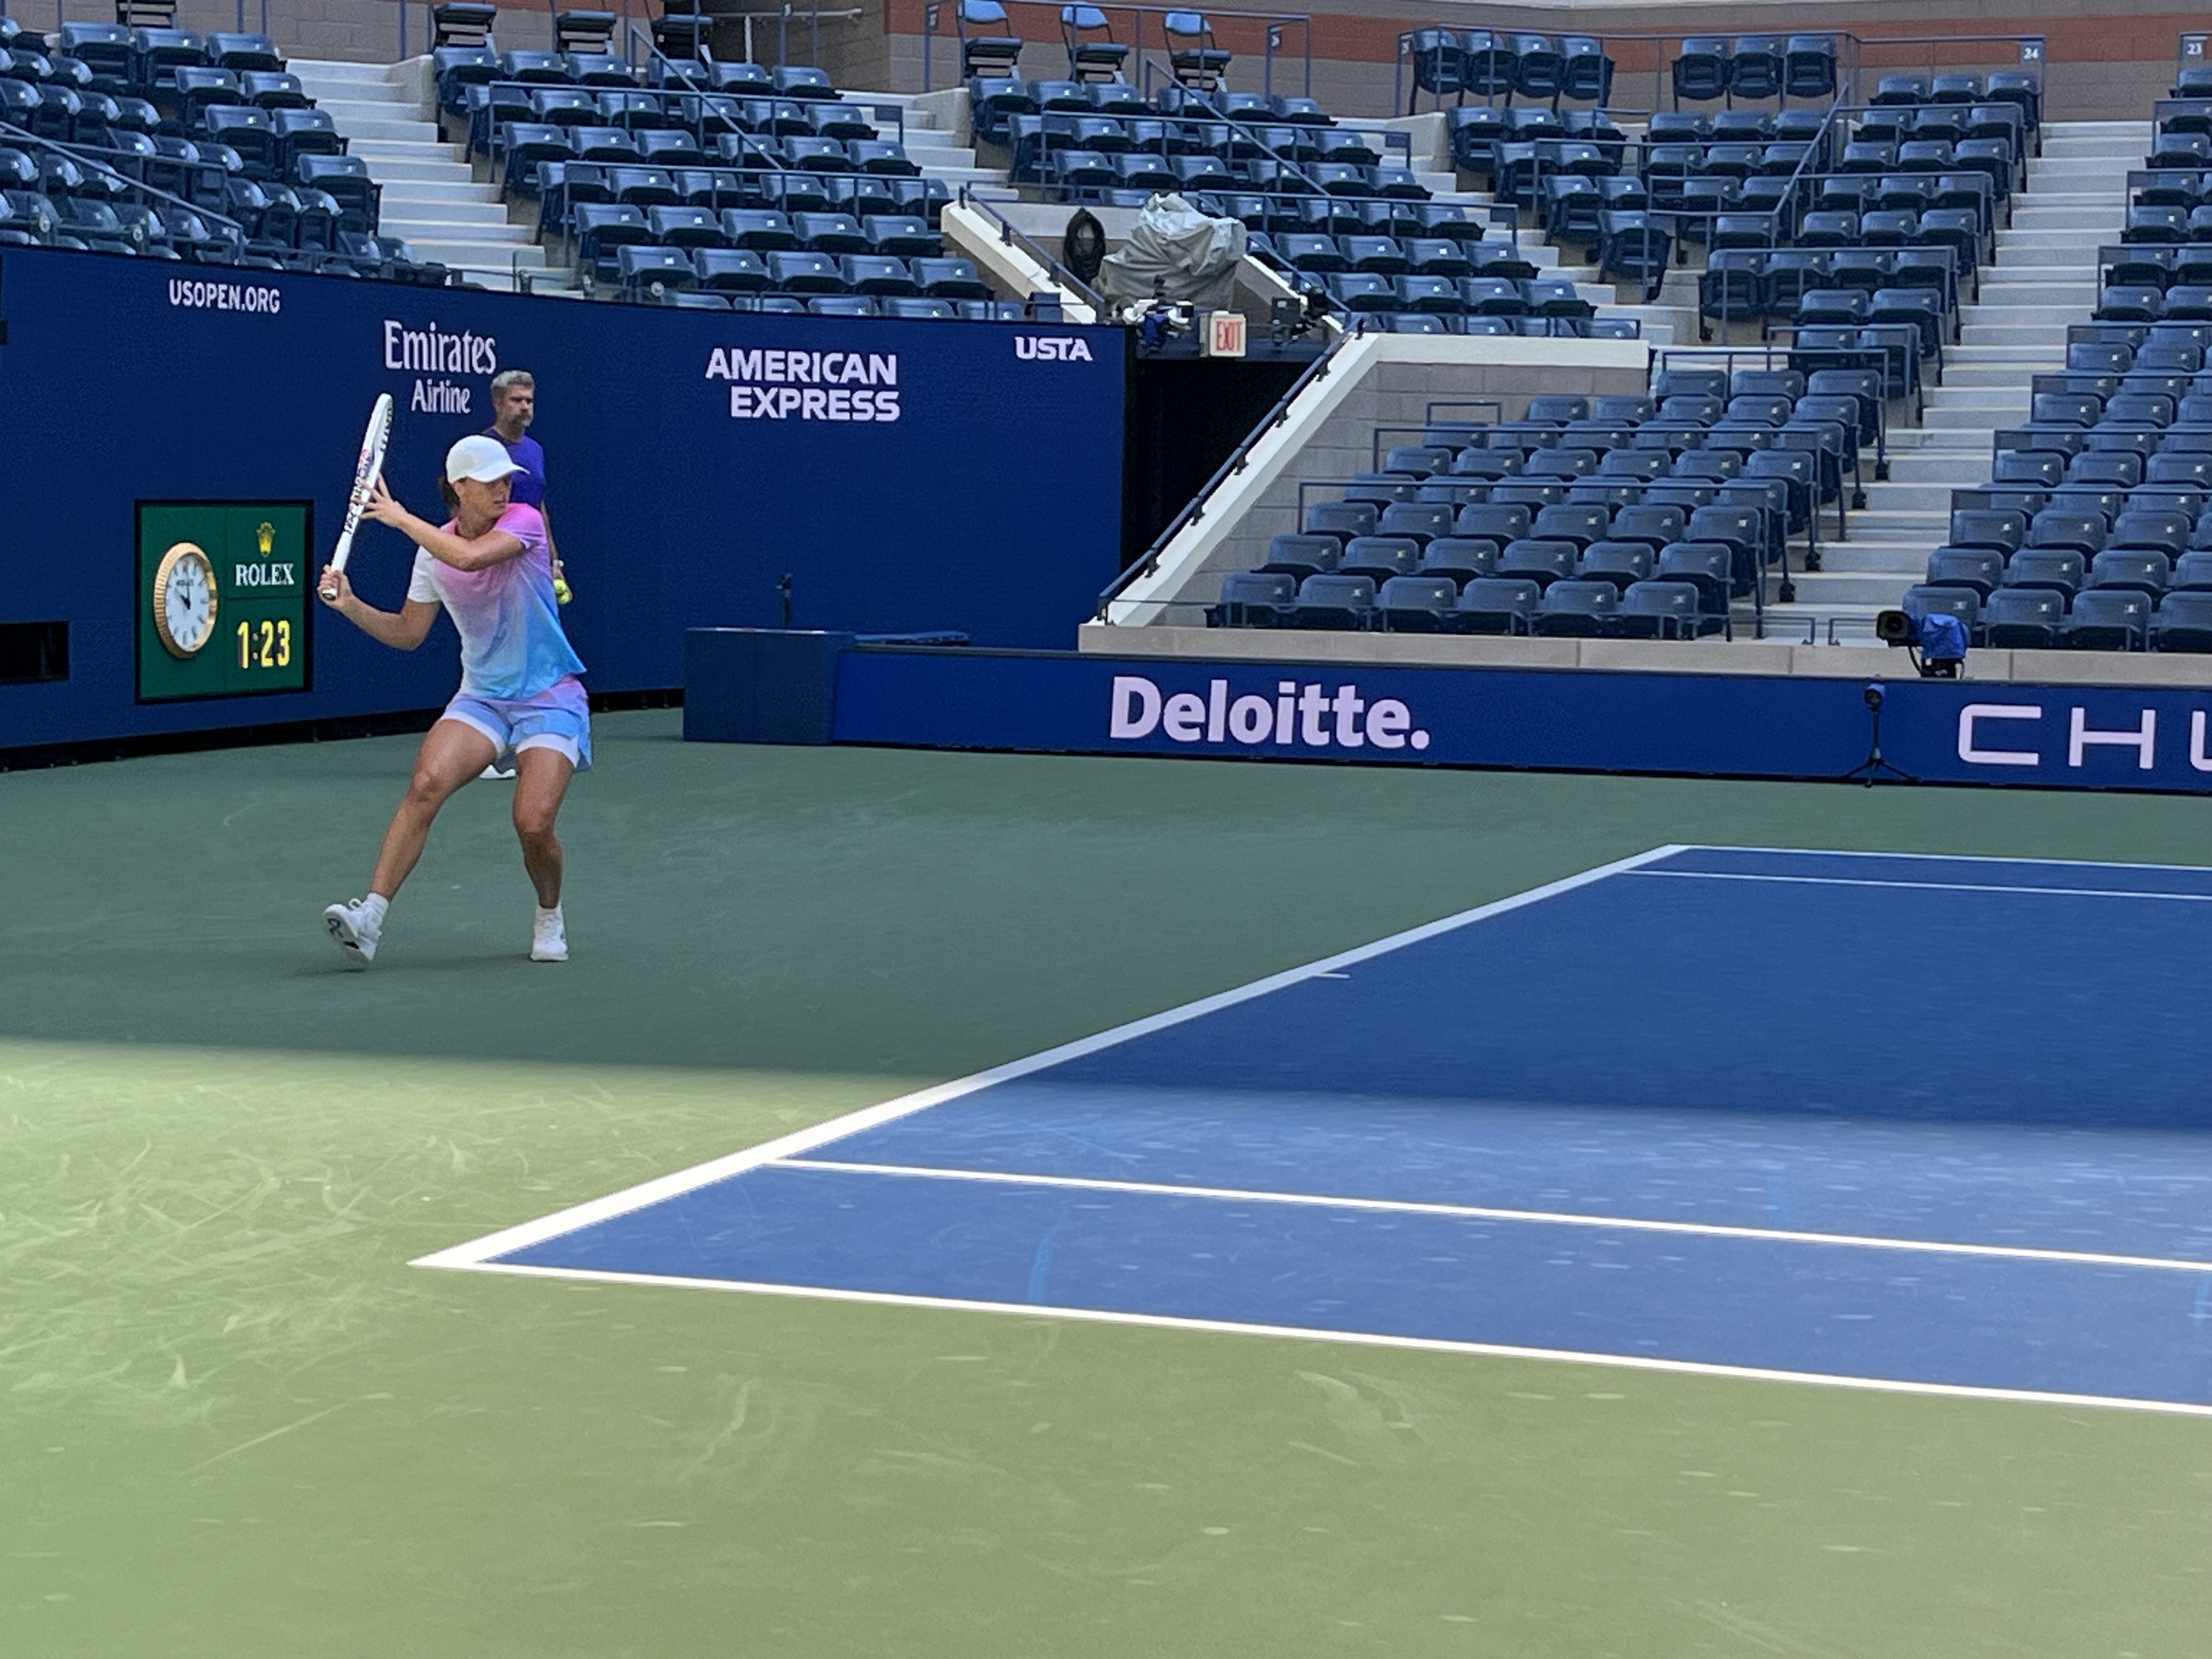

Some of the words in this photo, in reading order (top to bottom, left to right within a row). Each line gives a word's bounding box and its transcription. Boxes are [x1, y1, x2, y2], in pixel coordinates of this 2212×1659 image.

[169, 279, 280, 313] USOPEN.ORG
[383, 320, 497, 375] Emirates
[1015, 336, 1093, 362] USTA
[1216, 320, 1243, 352] EXIT
[706, 348, 897, 385] AMERICAN
[411, 379, 471, 414] Airline
[731, 386, 900, 421] EXPRESS
[235, 563, 295, 586] ROLEX
[237, 619, 291, 669] 1:23
[1109, 676, 1430, 750] Deloitte.
[1957, 704, 2212, 771] CH
